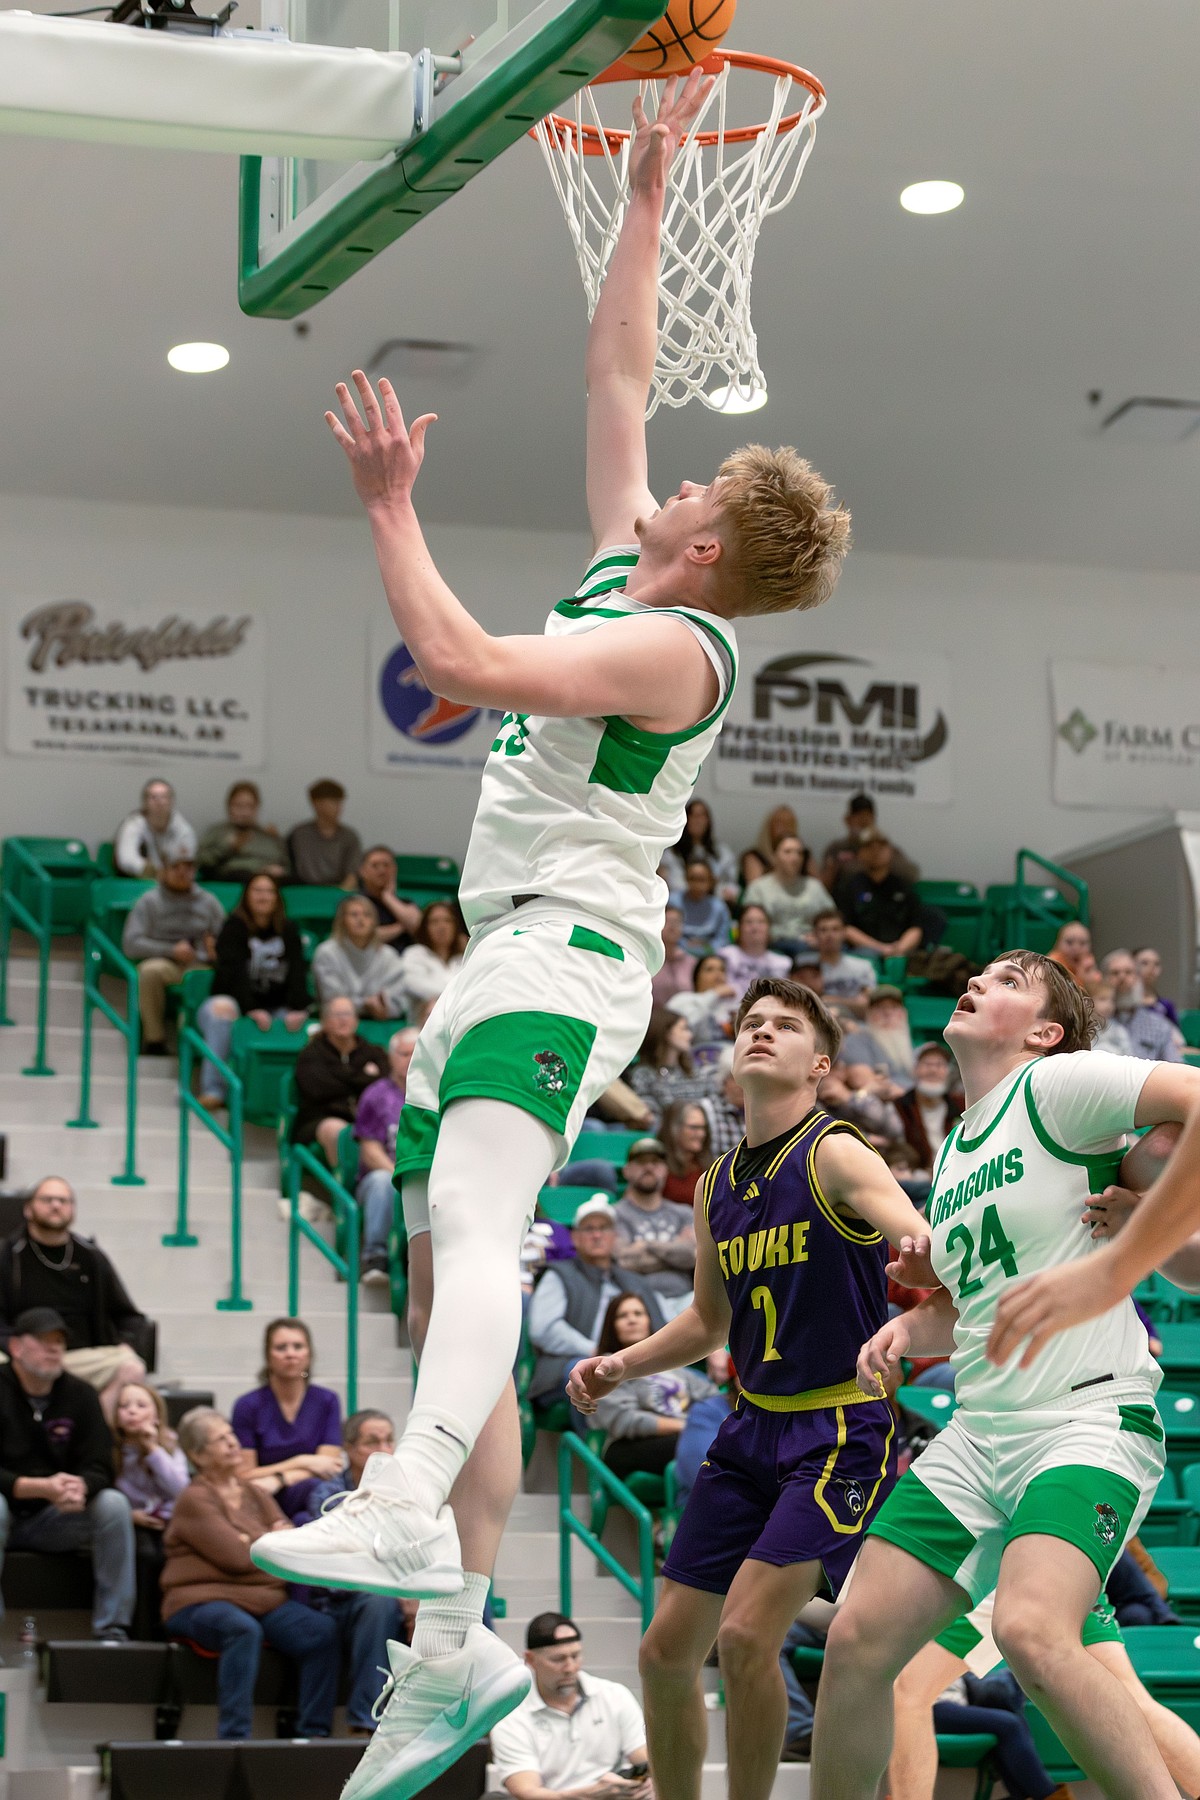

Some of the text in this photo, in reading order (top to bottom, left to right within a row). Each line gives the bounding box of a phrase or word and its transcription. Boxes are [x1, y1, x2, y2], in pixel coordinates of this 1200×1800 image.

[25, 687, 249, 720] TRUCKING LLC.
[754, 674, 919, 729] PMI
[1104, 720, 1174, 750] FARM
[933, 1147, 1025, 1231] DRAGONS
[717, 1220, 811, 1281] FOUKE
[945, 1203, 1019, 1299] 24
[751, 1285, 783, 1363] 2
